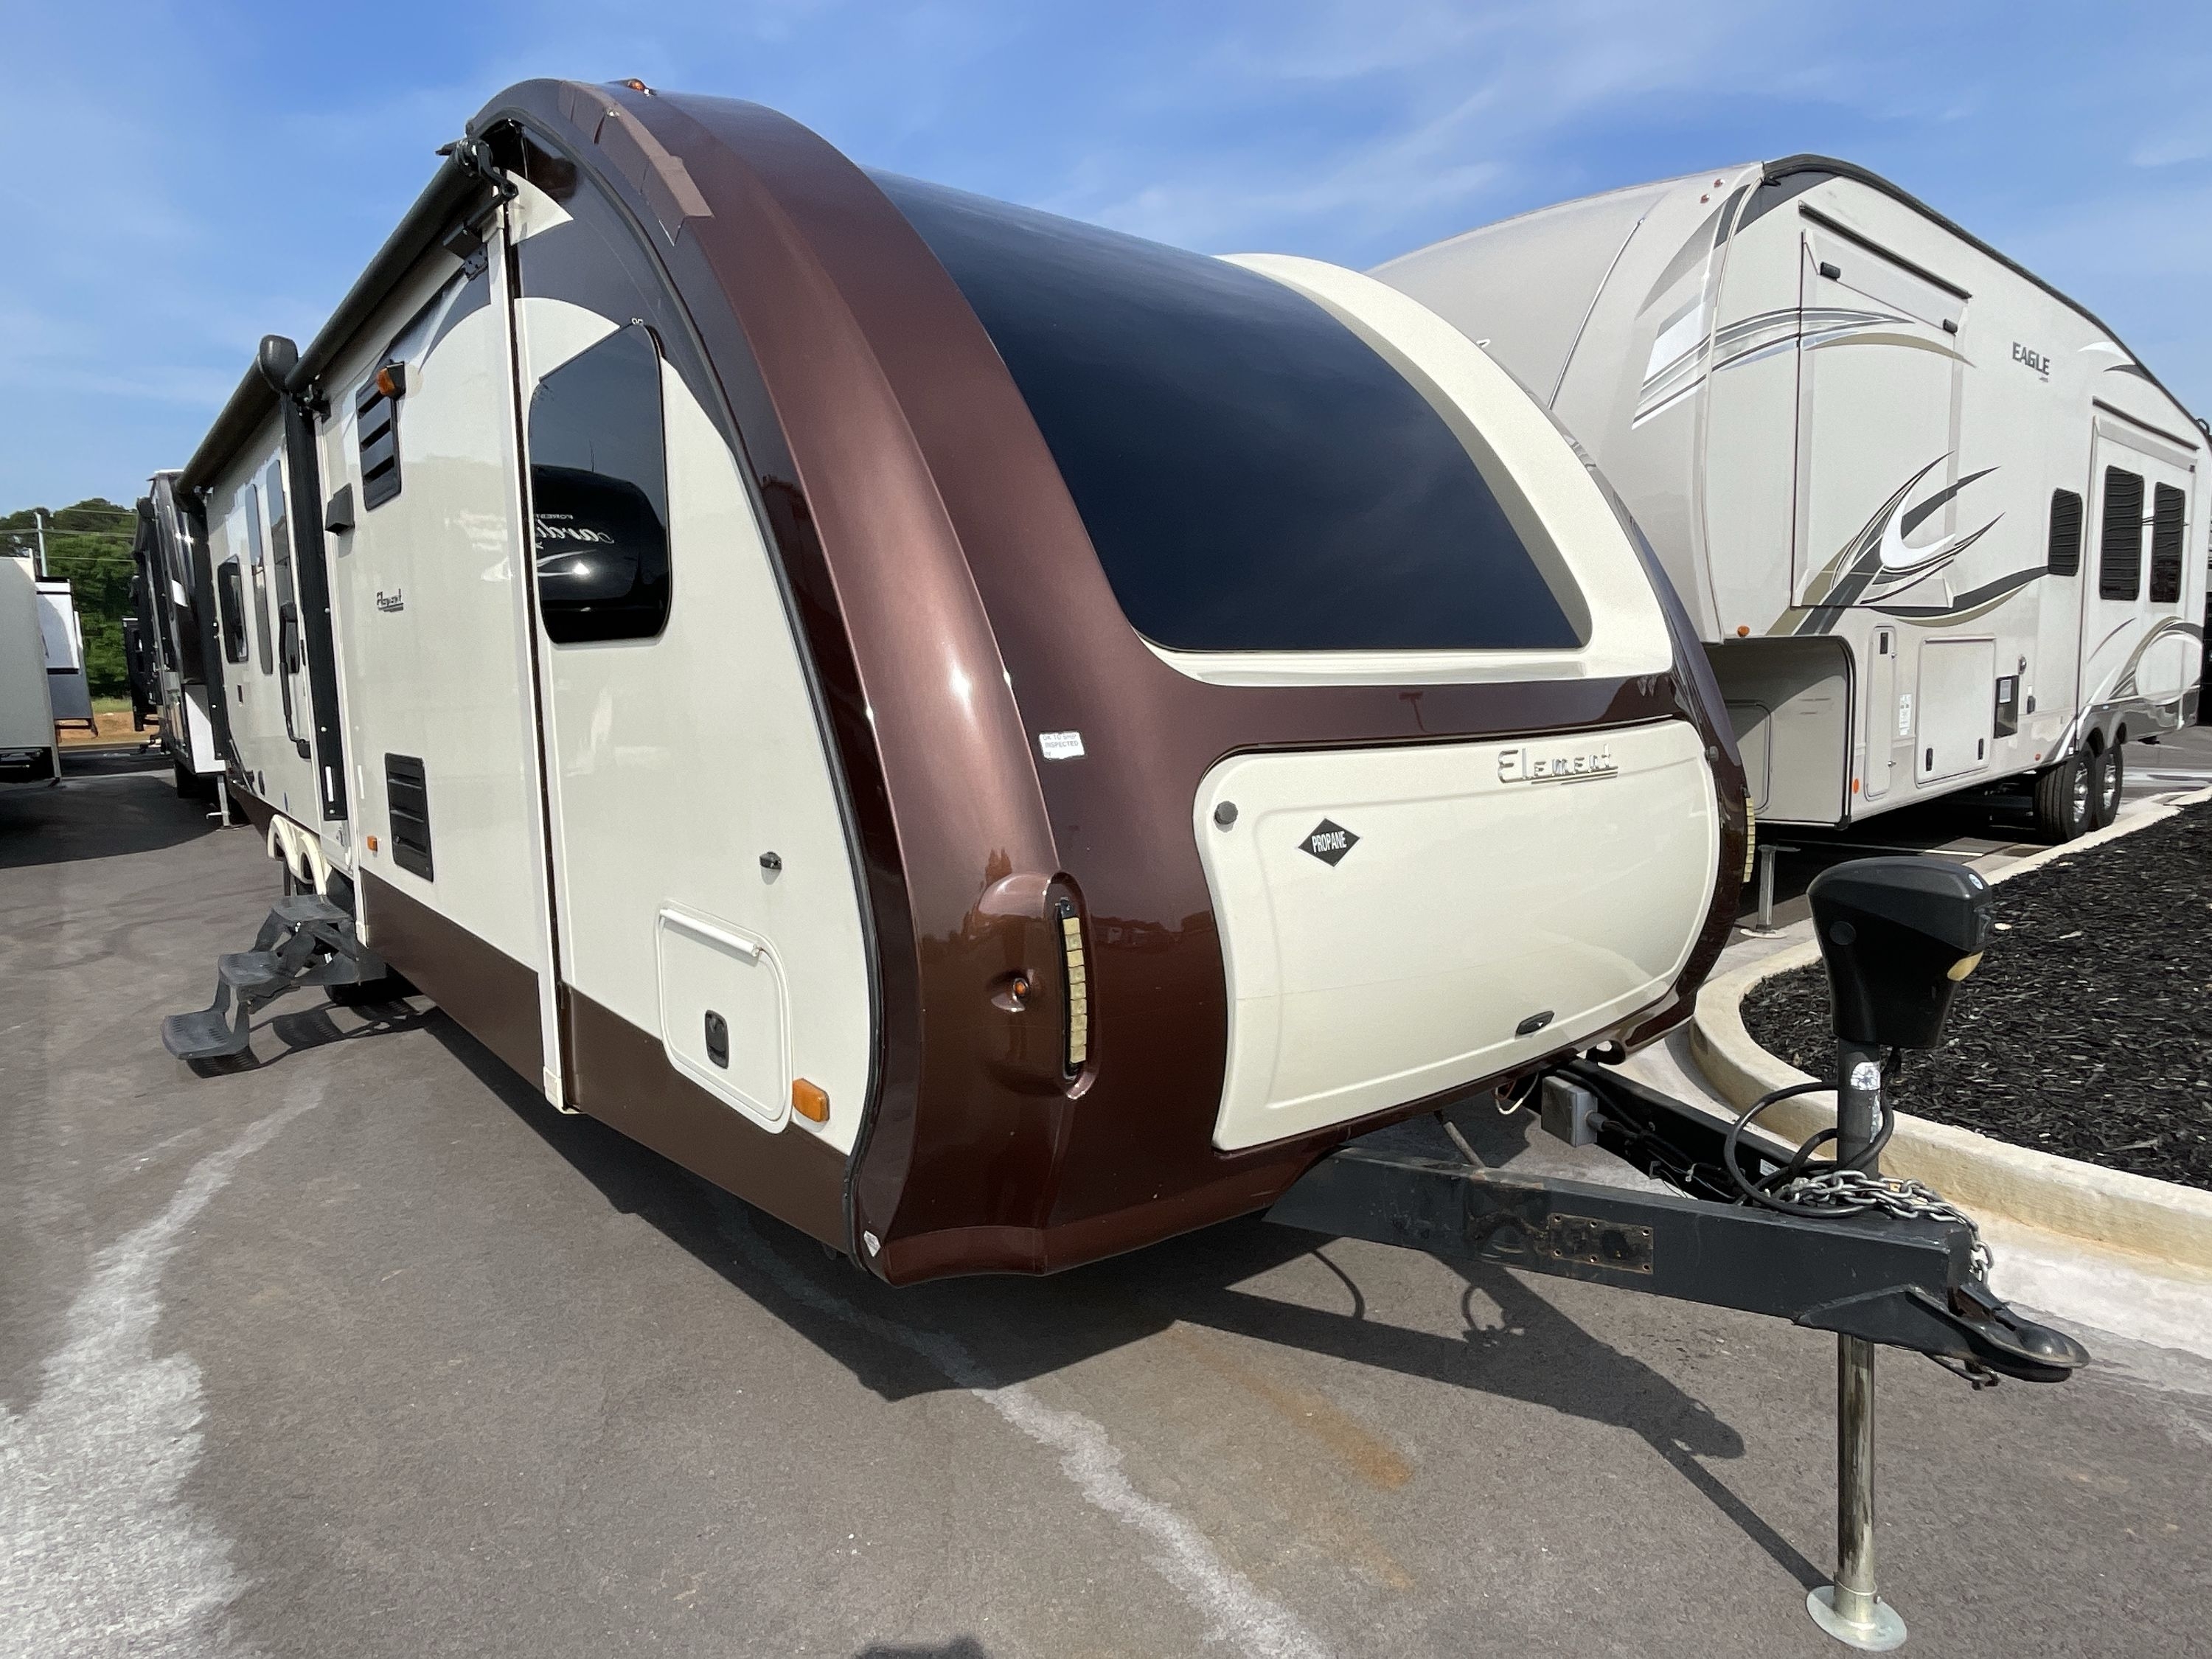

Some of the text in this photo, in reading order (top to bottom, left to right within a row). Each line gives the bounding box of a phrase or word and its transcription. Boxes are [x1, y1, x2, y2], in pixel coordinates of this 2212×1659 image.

[2012, 341, 2050, 375] EAGLE
[1045, 740, 1079, 748] INSPECTED
[1498, 744, 1618, 785] Element
[1312, 830, 1347, 853] PROPANE
